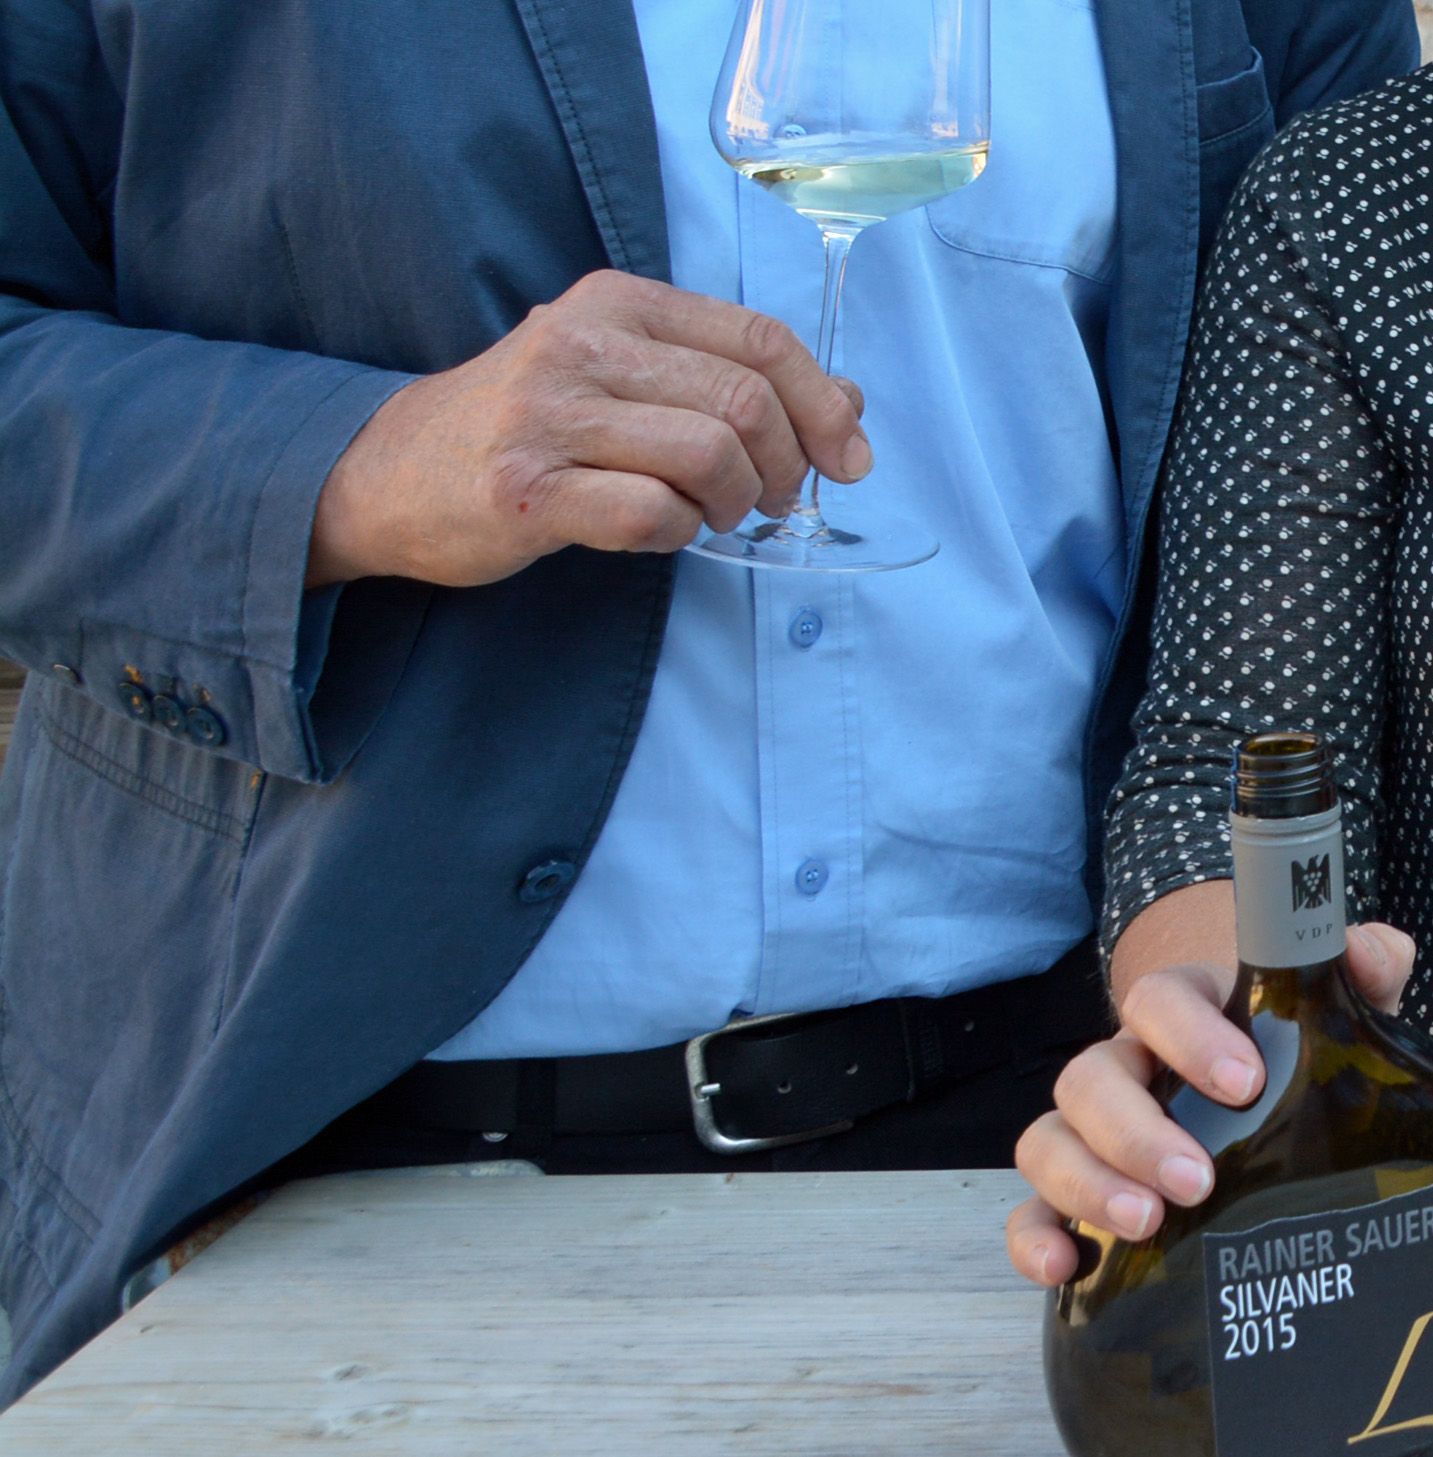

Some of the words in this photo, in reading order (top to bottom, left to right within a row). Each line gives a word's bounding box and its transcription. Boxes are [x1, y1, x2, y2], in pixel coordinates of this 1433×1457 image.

[1218, 1229, 1336, 1282] RAINER
[1219, 1263, 1355, 1322] SILVANER
[1223, 1312, 1297, 1360] 2015
